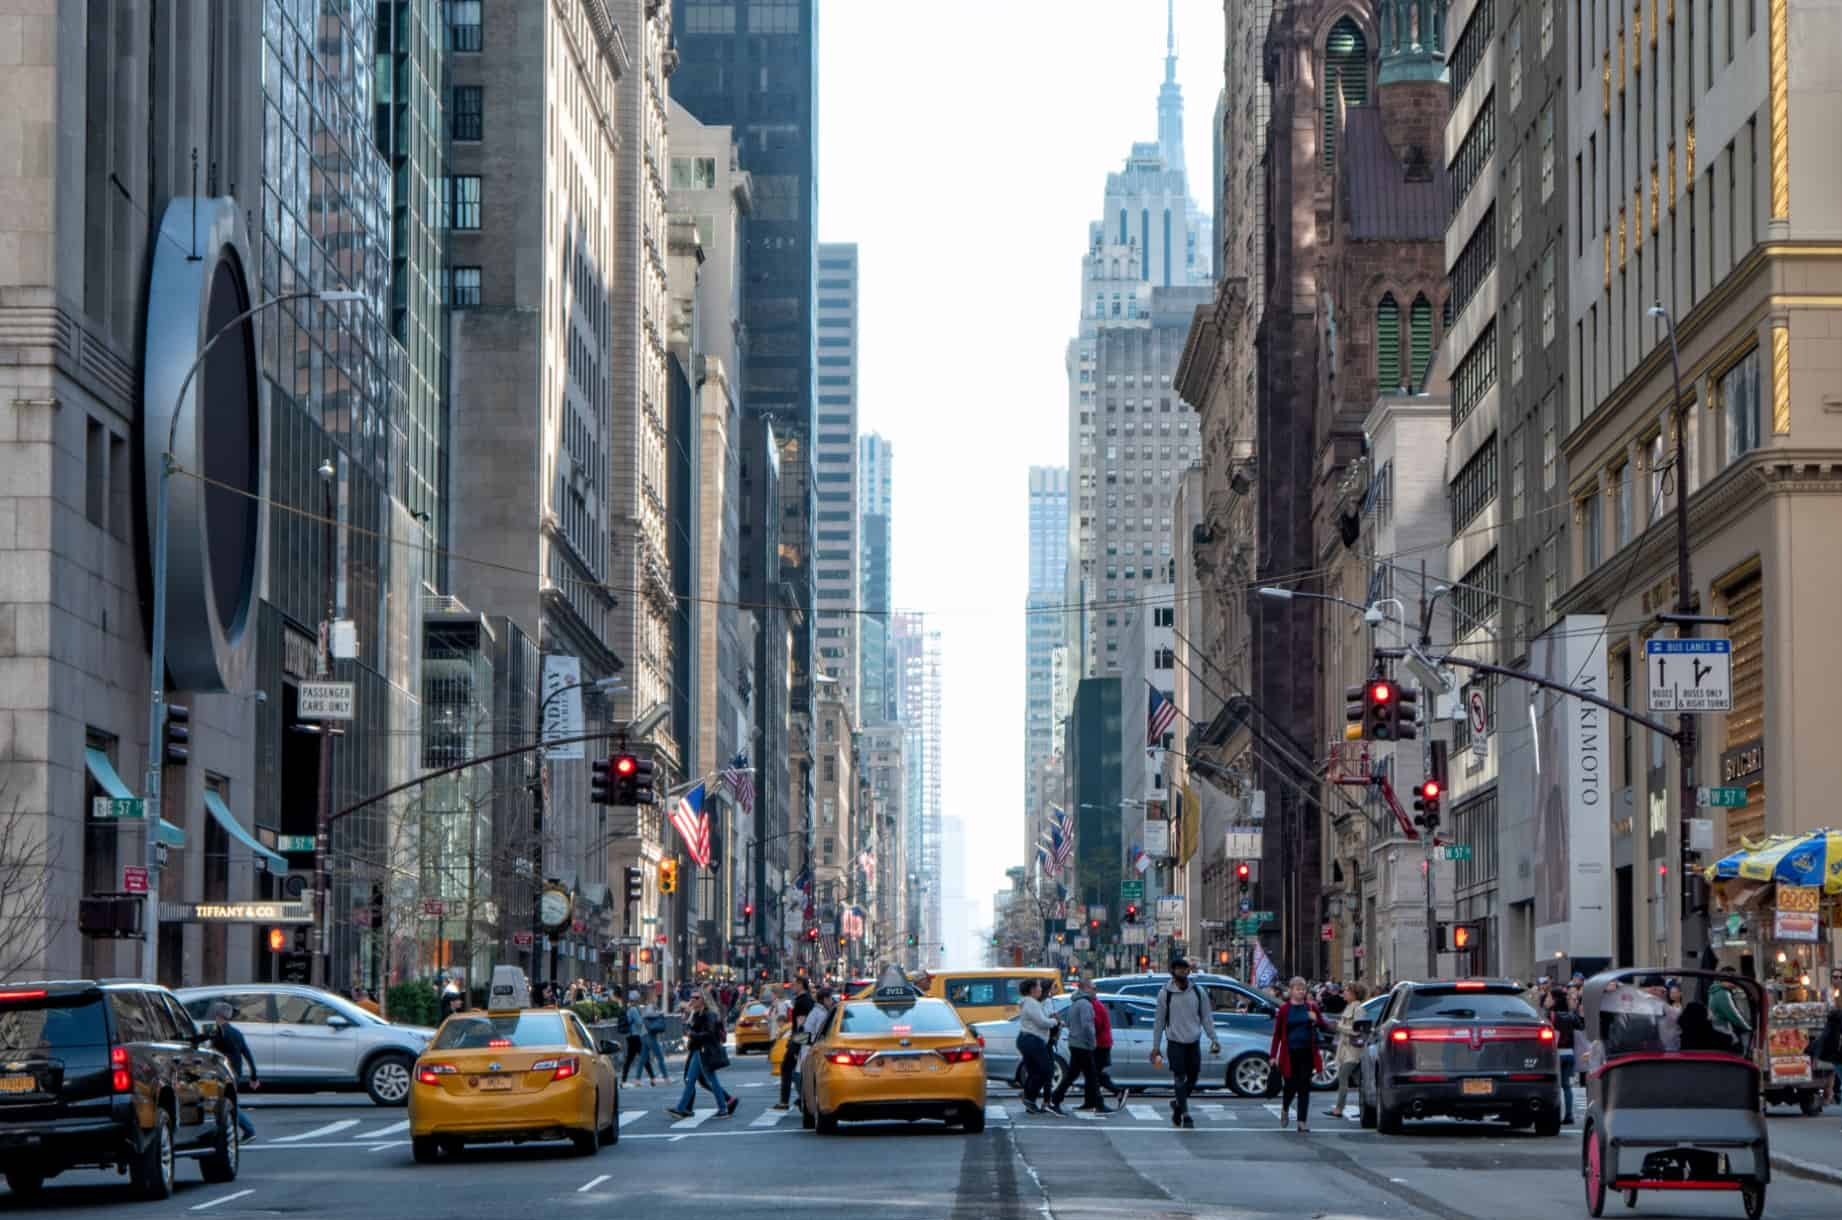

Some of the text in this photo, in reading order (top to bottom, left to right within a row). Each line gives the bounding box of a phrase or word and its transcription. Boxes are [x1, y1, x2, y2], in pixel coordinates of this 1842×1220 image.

[1666, 642, 1711, 651] BUS LANES
[302, 687, 350, 698] PASSENGER
[1652, 689, 1673, 698] BUSES
[1683, 689, 1723, 698] BUSES ONLY
[302, 700, 351, 712] CARS ONLY
[1654, 700, 1672, 708] ONLY
[1686, 700, 1705, 708] RIGHT
[1707, 700, 1729, 708] TURNS
[1580, 675, 1599, 806] MKIMOTO
[1711, 789, 1720, 805] W
[1724, 789, 1736, 805] 57
[117, 800, 131, 815] 57
[195, 905, 243, 918] TIFFANY
[245, 906, 255, 917] &
